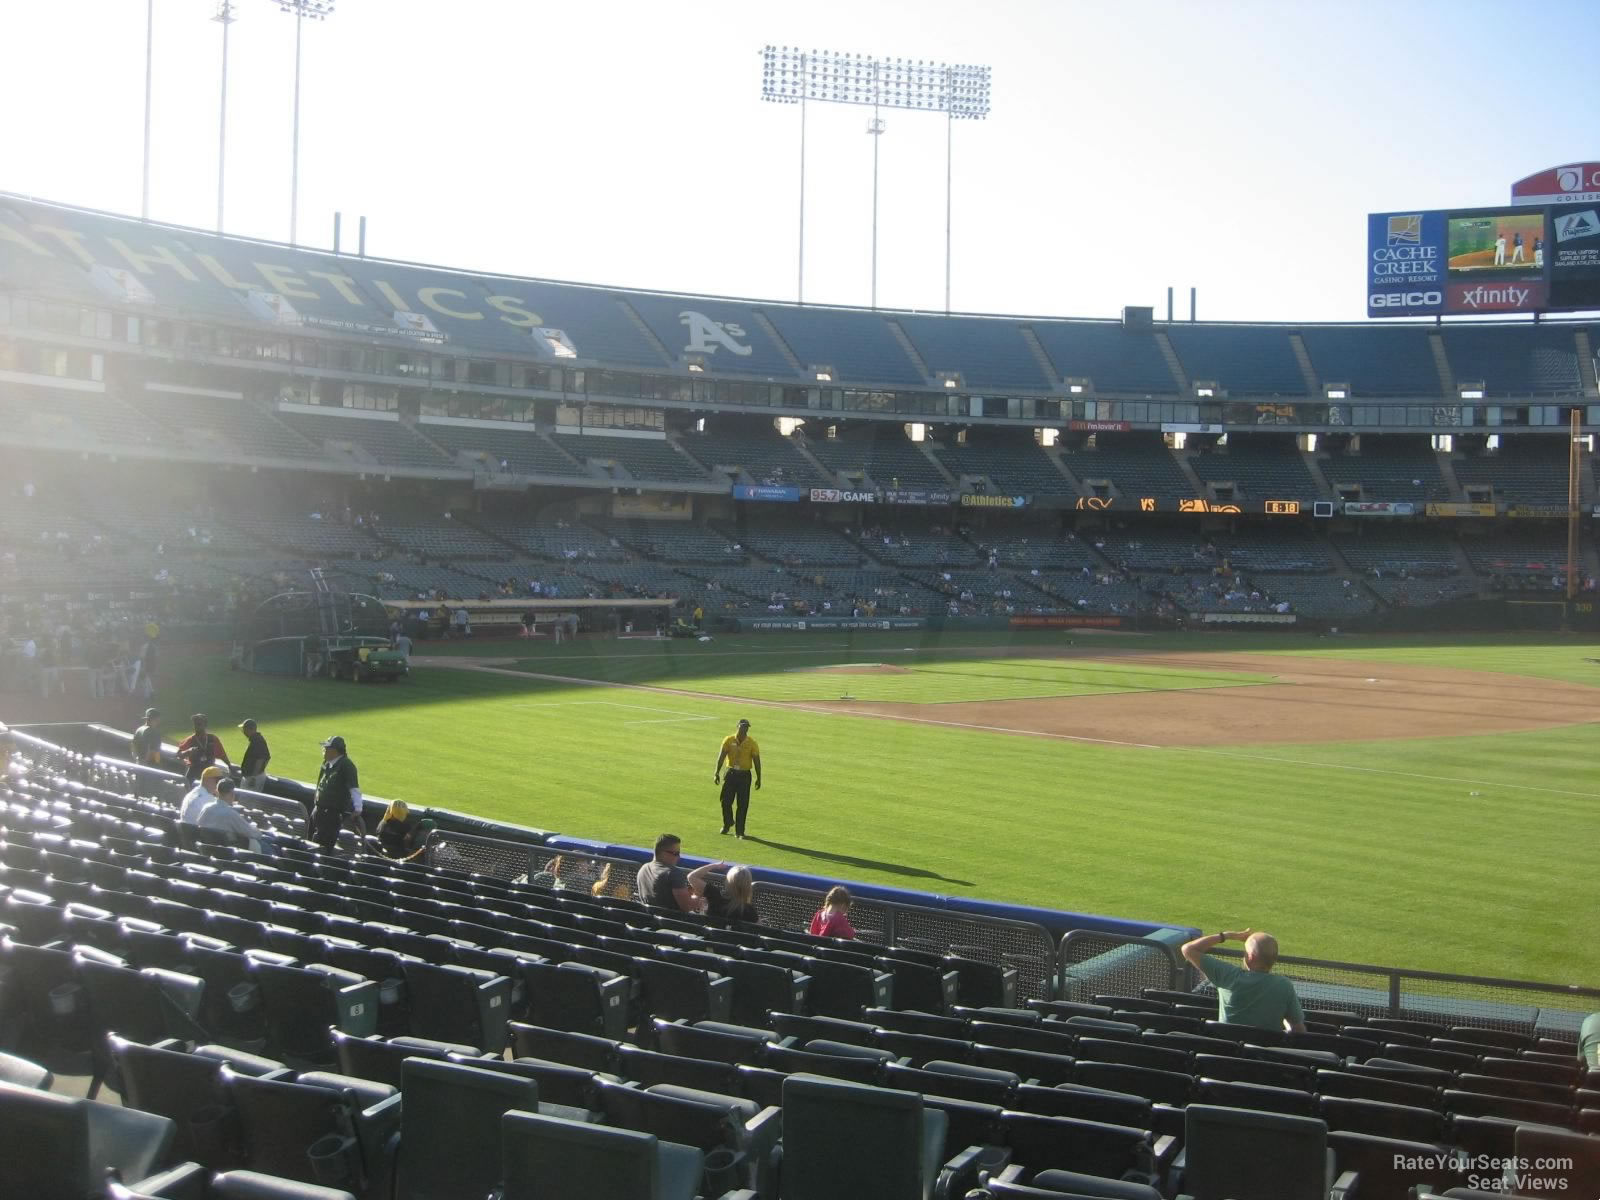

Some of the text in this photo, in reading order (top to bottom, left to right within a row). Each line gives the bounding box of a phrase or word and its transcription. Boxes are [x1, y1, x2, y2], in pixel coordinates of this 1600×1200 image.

[1373, 246, 1437, 261] CACHE
[1373, 260, 1437, 275] CREEK
[1374, 275, 1438, 284] CASINO RESORT
[1369, 292, 1442, 308] GEICO
[1463, 286, 1529, 308] xfinity
[843, 491, 875, 502] GAME
[1140, 498, 1155, 511] VS
[1272, 502, 1297, 513] 6:18
